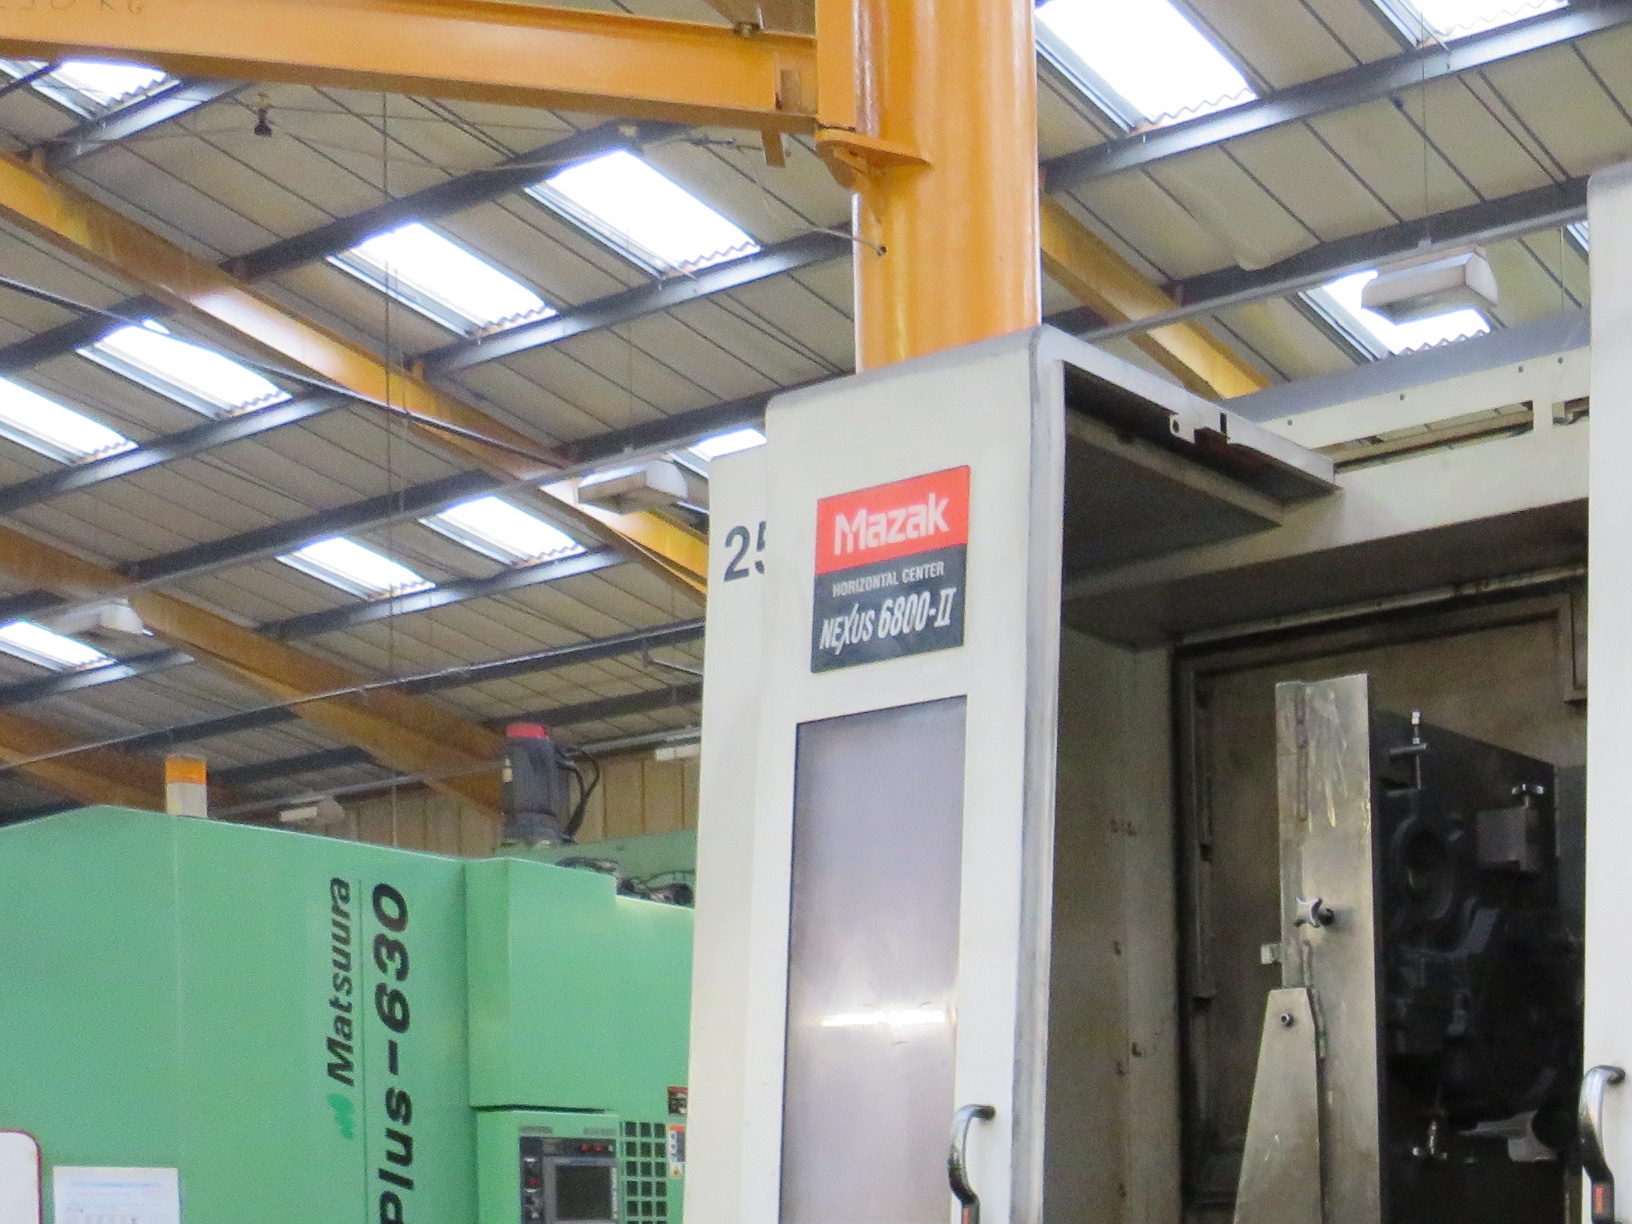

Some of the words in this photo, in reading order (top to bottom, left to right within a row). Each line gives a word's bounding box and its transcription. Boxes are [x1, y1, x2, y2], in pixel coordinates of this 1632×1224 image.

[833, 491, 950, 557] Mazak
[831, 571, 900, 598] HORIZONTAL
[901, 560, 945, 584] CENTER
[818, 602, 876, 656] NEXUS
[325, 876, 355, 1087] Matsuura
